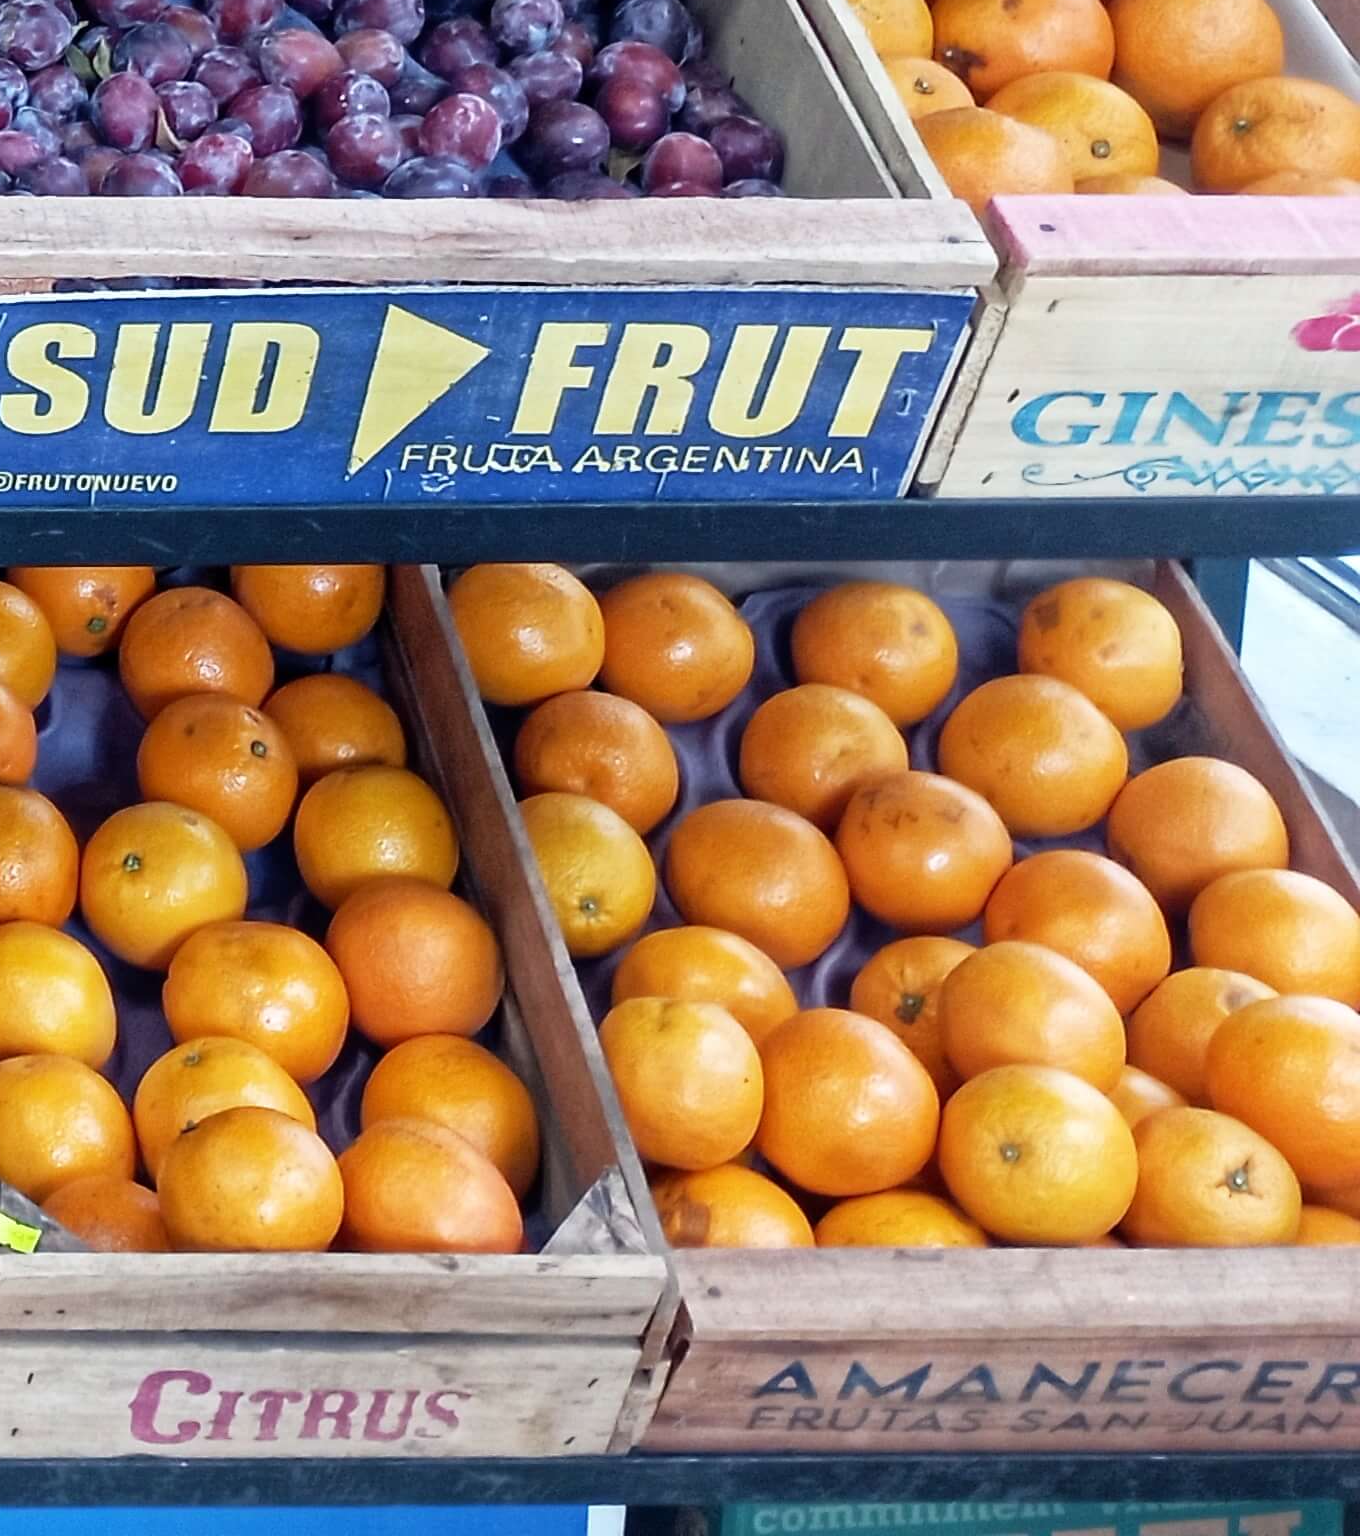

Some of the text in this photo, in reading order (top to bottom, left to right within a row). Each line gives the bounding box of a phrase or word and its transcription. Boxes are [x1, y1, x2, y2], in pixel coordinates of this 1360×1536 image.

[511, 320, 935, 438] FRUT
[400, 442, 866, 475] FRUTA ARGENTINA
[751, 1359, 1360, 1405] AMANECER
[129, 1369, 474, 1446] CITRUS
[747, 1405, 1344, 1434] FRUTAS SAN JUAN
